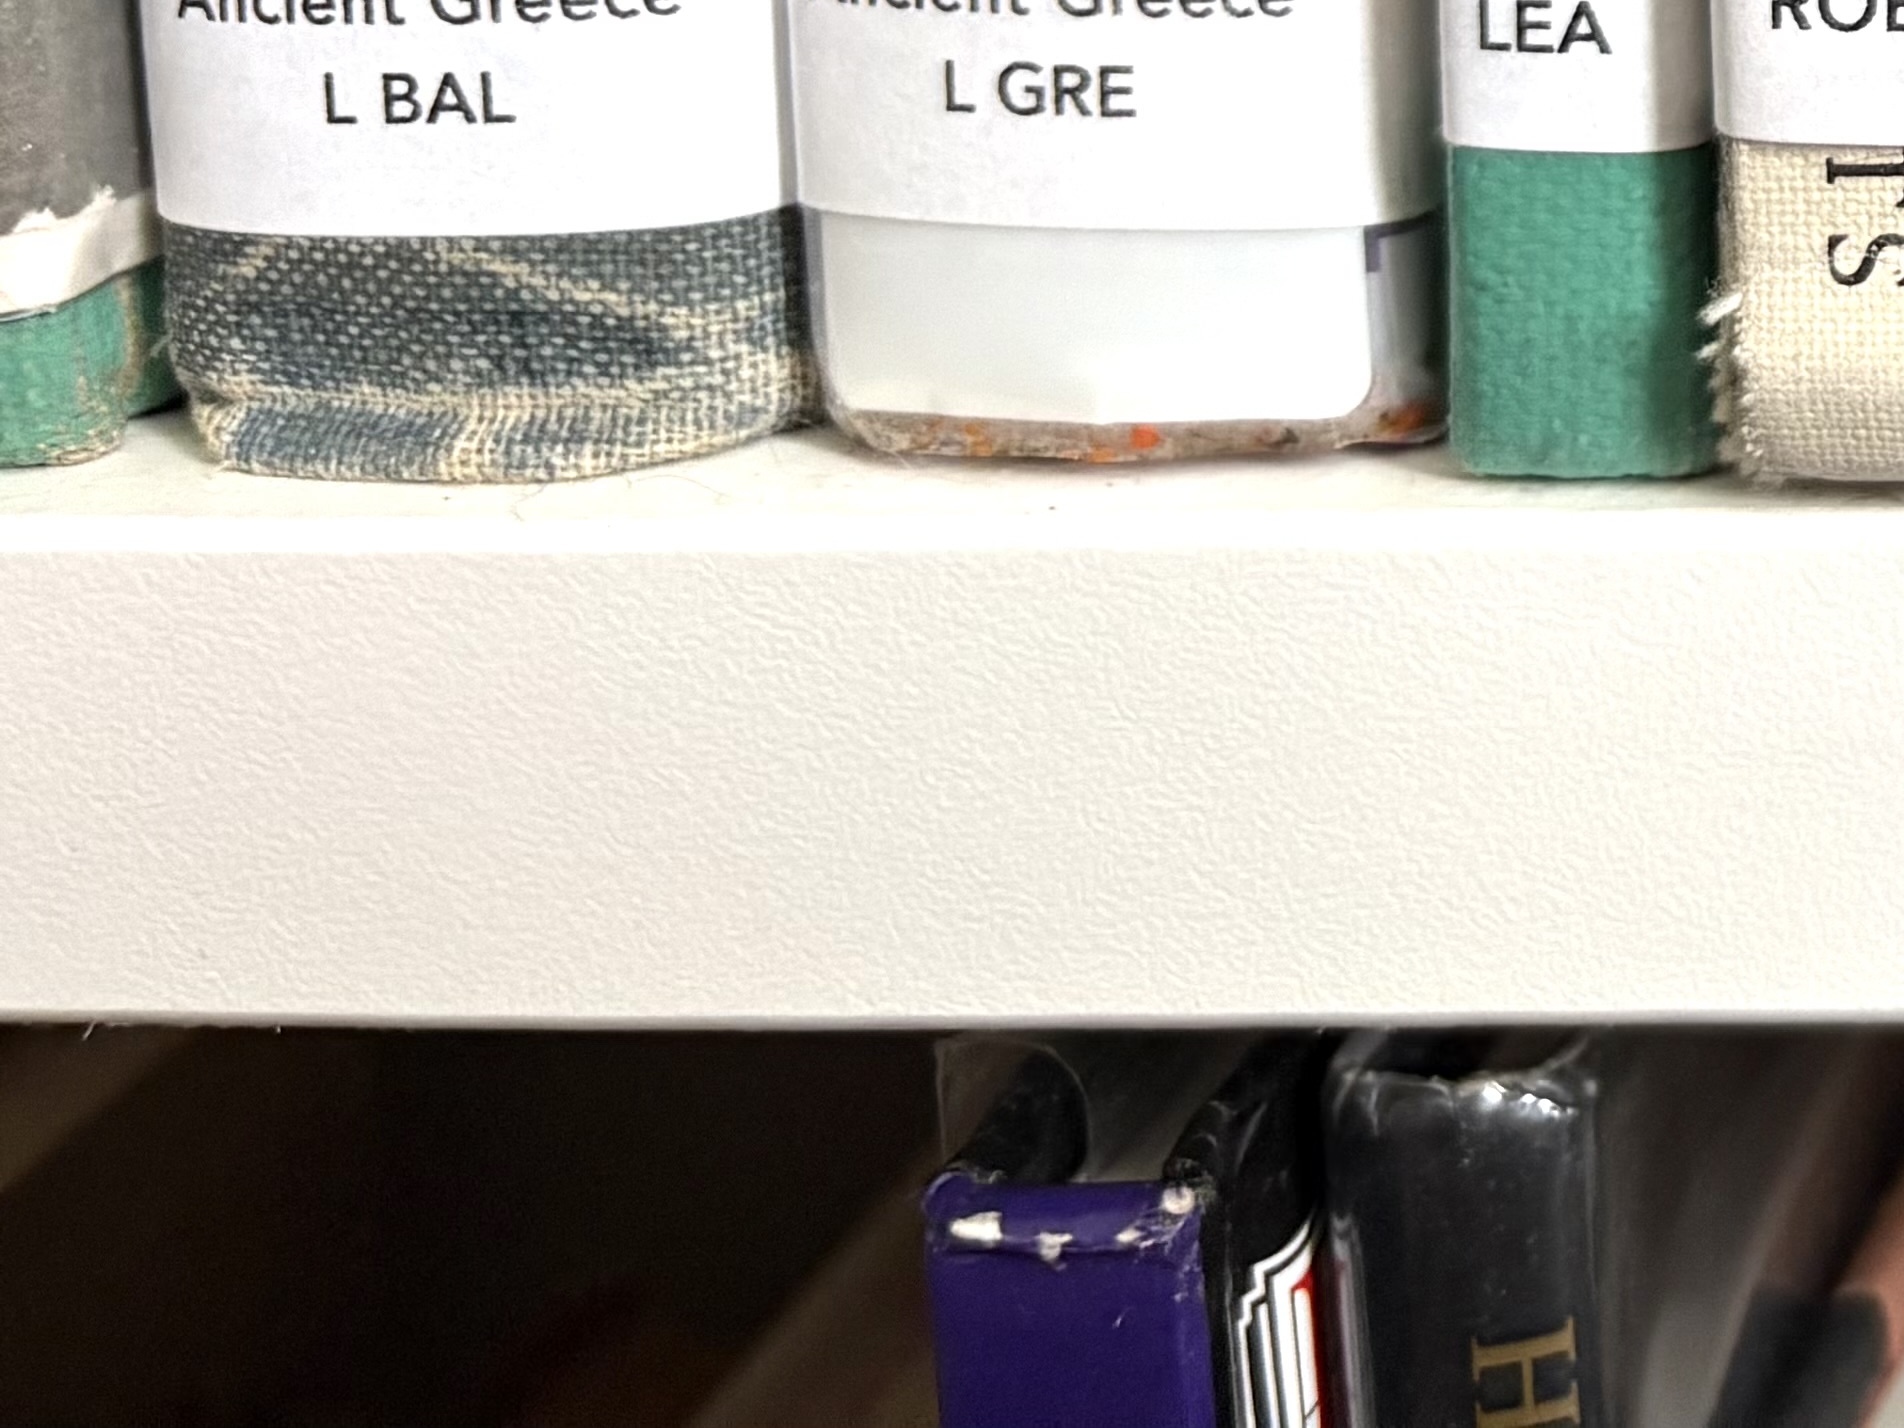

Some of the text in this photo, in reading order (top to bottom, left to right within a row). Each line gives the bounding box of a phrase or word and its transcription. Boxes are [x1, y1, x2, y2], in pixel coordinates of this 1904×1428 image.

[322, 70, 517, 126] L BAL
[943, 58, 1137, 120] L GRE
